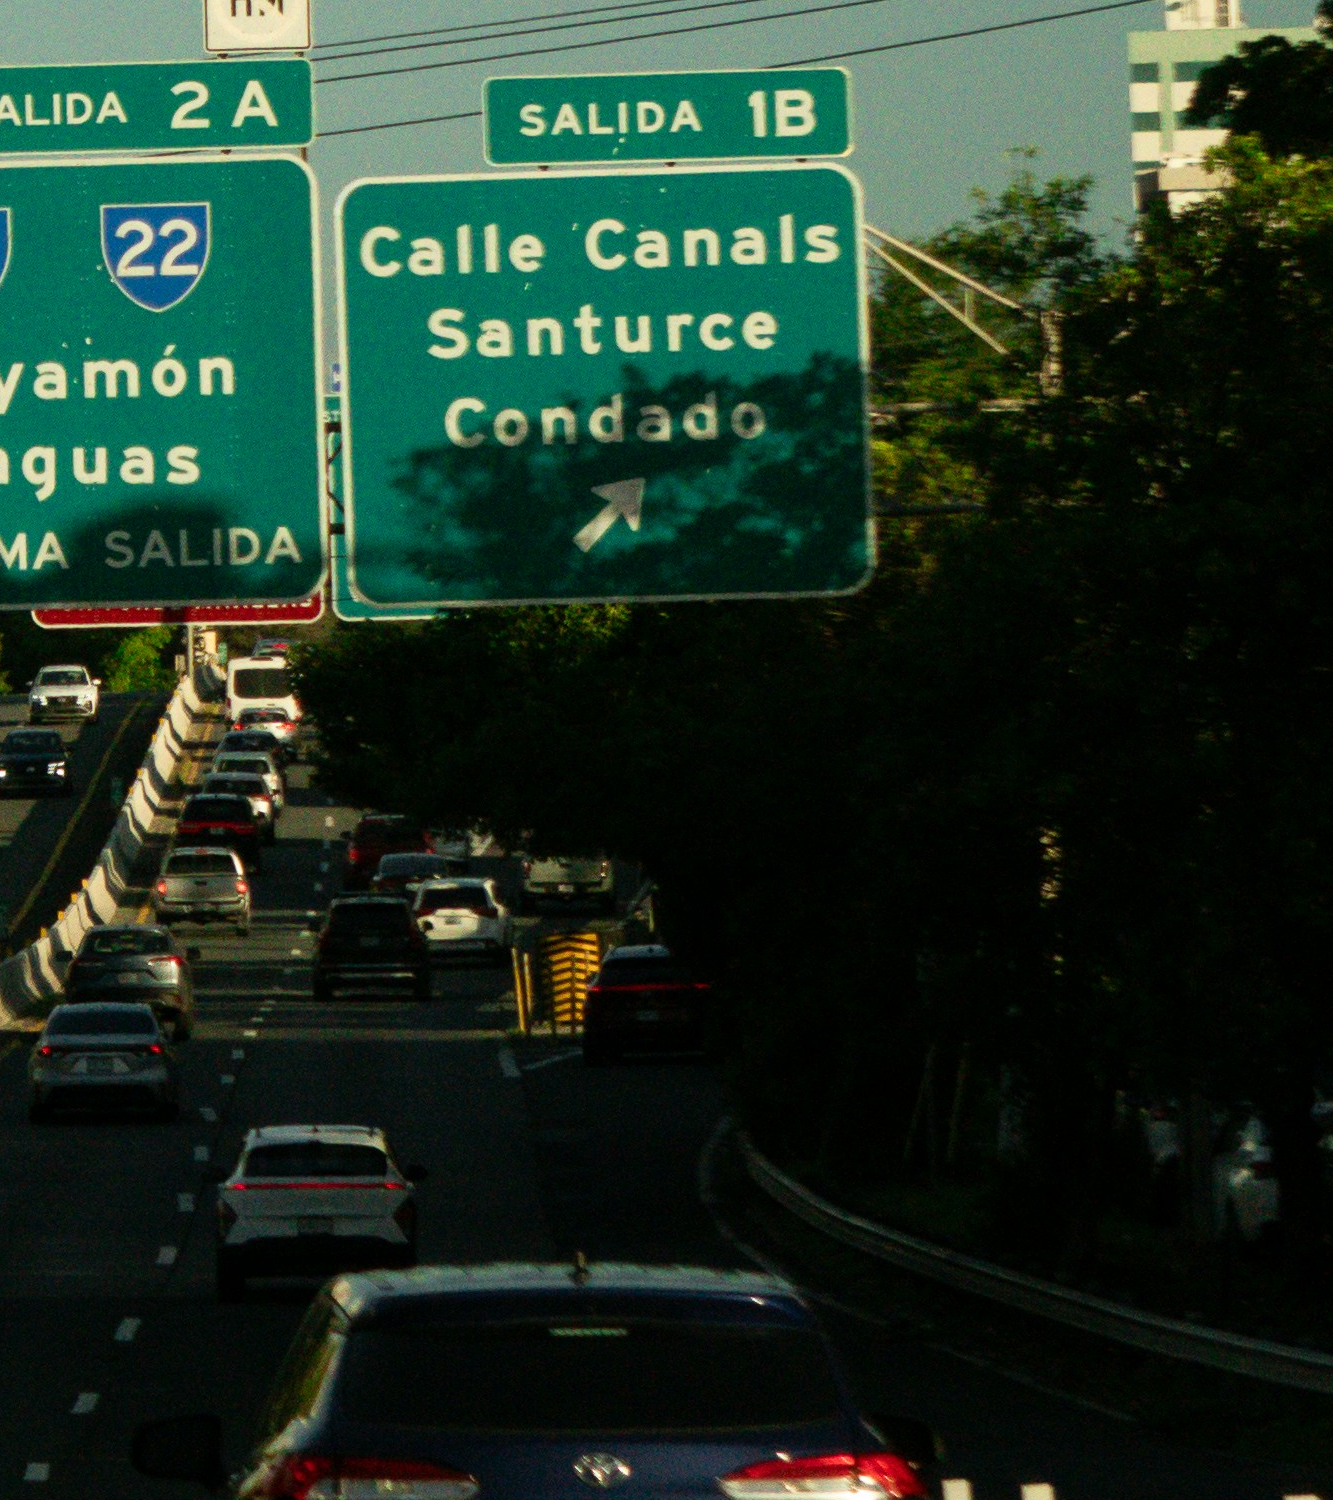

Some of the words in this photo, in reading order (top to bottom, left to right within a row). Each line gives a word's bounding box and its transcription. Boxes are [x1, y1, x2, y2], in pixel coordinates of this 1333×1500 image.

[519, 100, 702, 137] SALIDA
[748, 89, 817, 137] 1B
[115, 218, 199, 277] 22
[360, 223, 545, 278] Calle
[584, 214, 840, 271] Canals
[427, 304, 779, 360] Santurce
[444, 394, 767, 448] Condado
[104, 526, 302, 570] SALIDA
